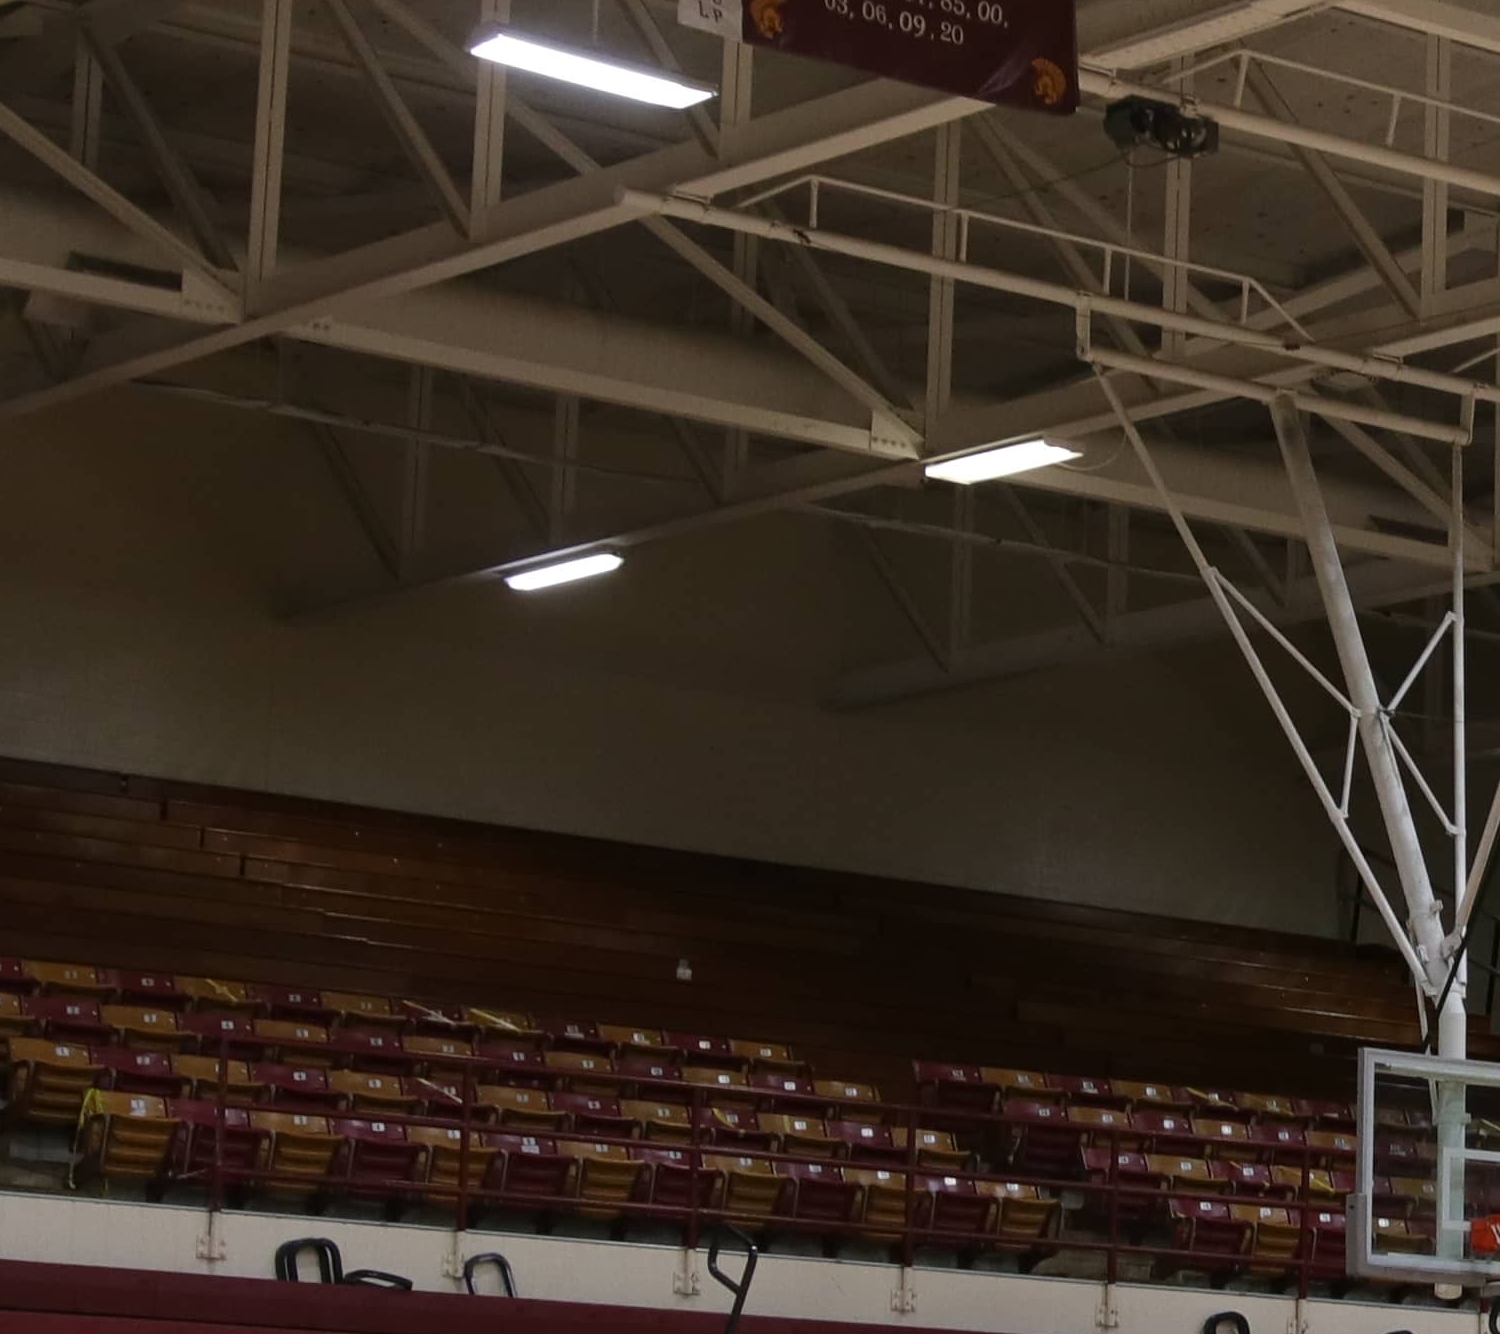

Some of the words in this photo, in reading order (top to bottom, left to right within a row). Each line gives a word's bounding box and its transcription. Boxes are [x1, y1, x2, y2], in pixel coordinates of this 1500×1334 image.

[862, 0, 894, 30] 06,
[940, 21, 964, 45] 20
[977, 0, 1009, 29] 00,
